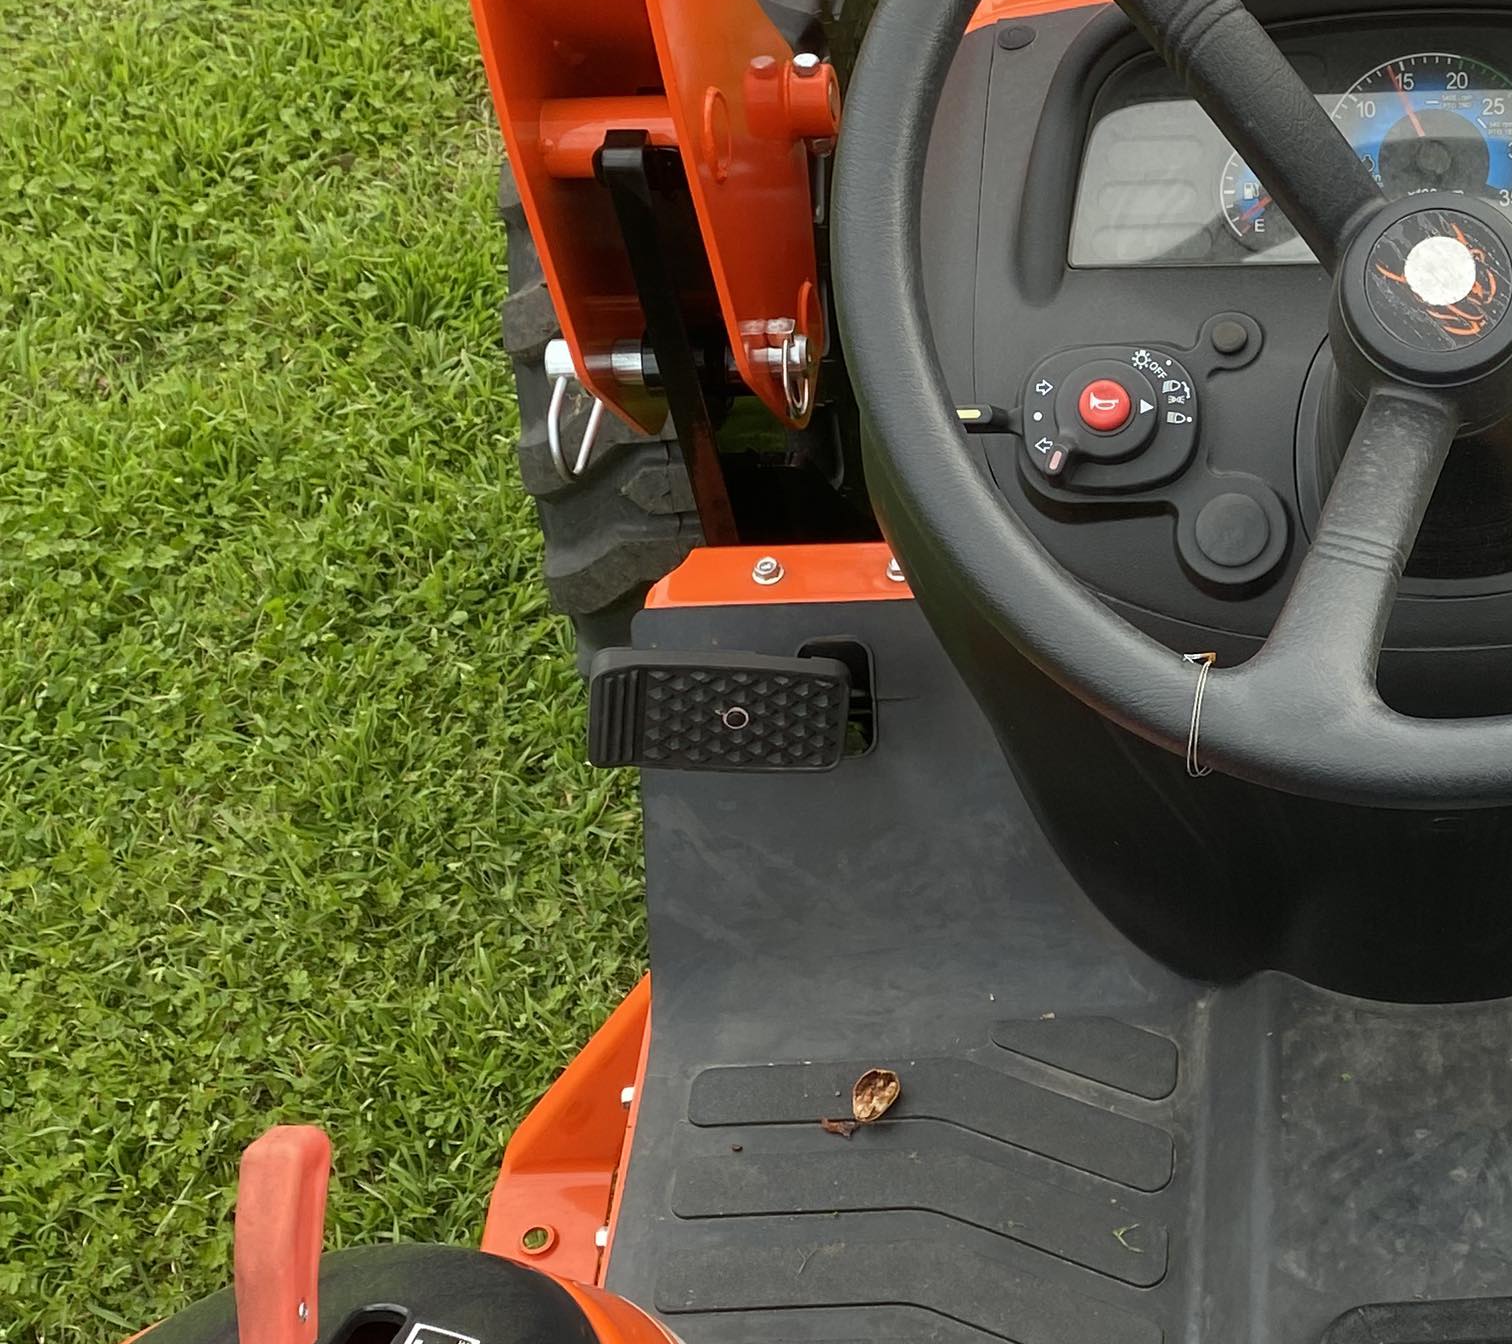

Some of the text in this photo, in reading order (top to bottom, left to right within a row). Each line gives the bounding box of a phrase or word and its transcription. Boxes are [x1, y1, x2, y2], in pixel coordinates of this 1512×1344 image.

[1395, 72, 1415, 91] 15
[1446, 72, 1469, 89] 20
[1356, 102, 1376, 119] 10
[1482, 98, 1506, 116] 25
[1254, 218, 1266, 233] E
[1148, 361, 1168, 379] OFF
